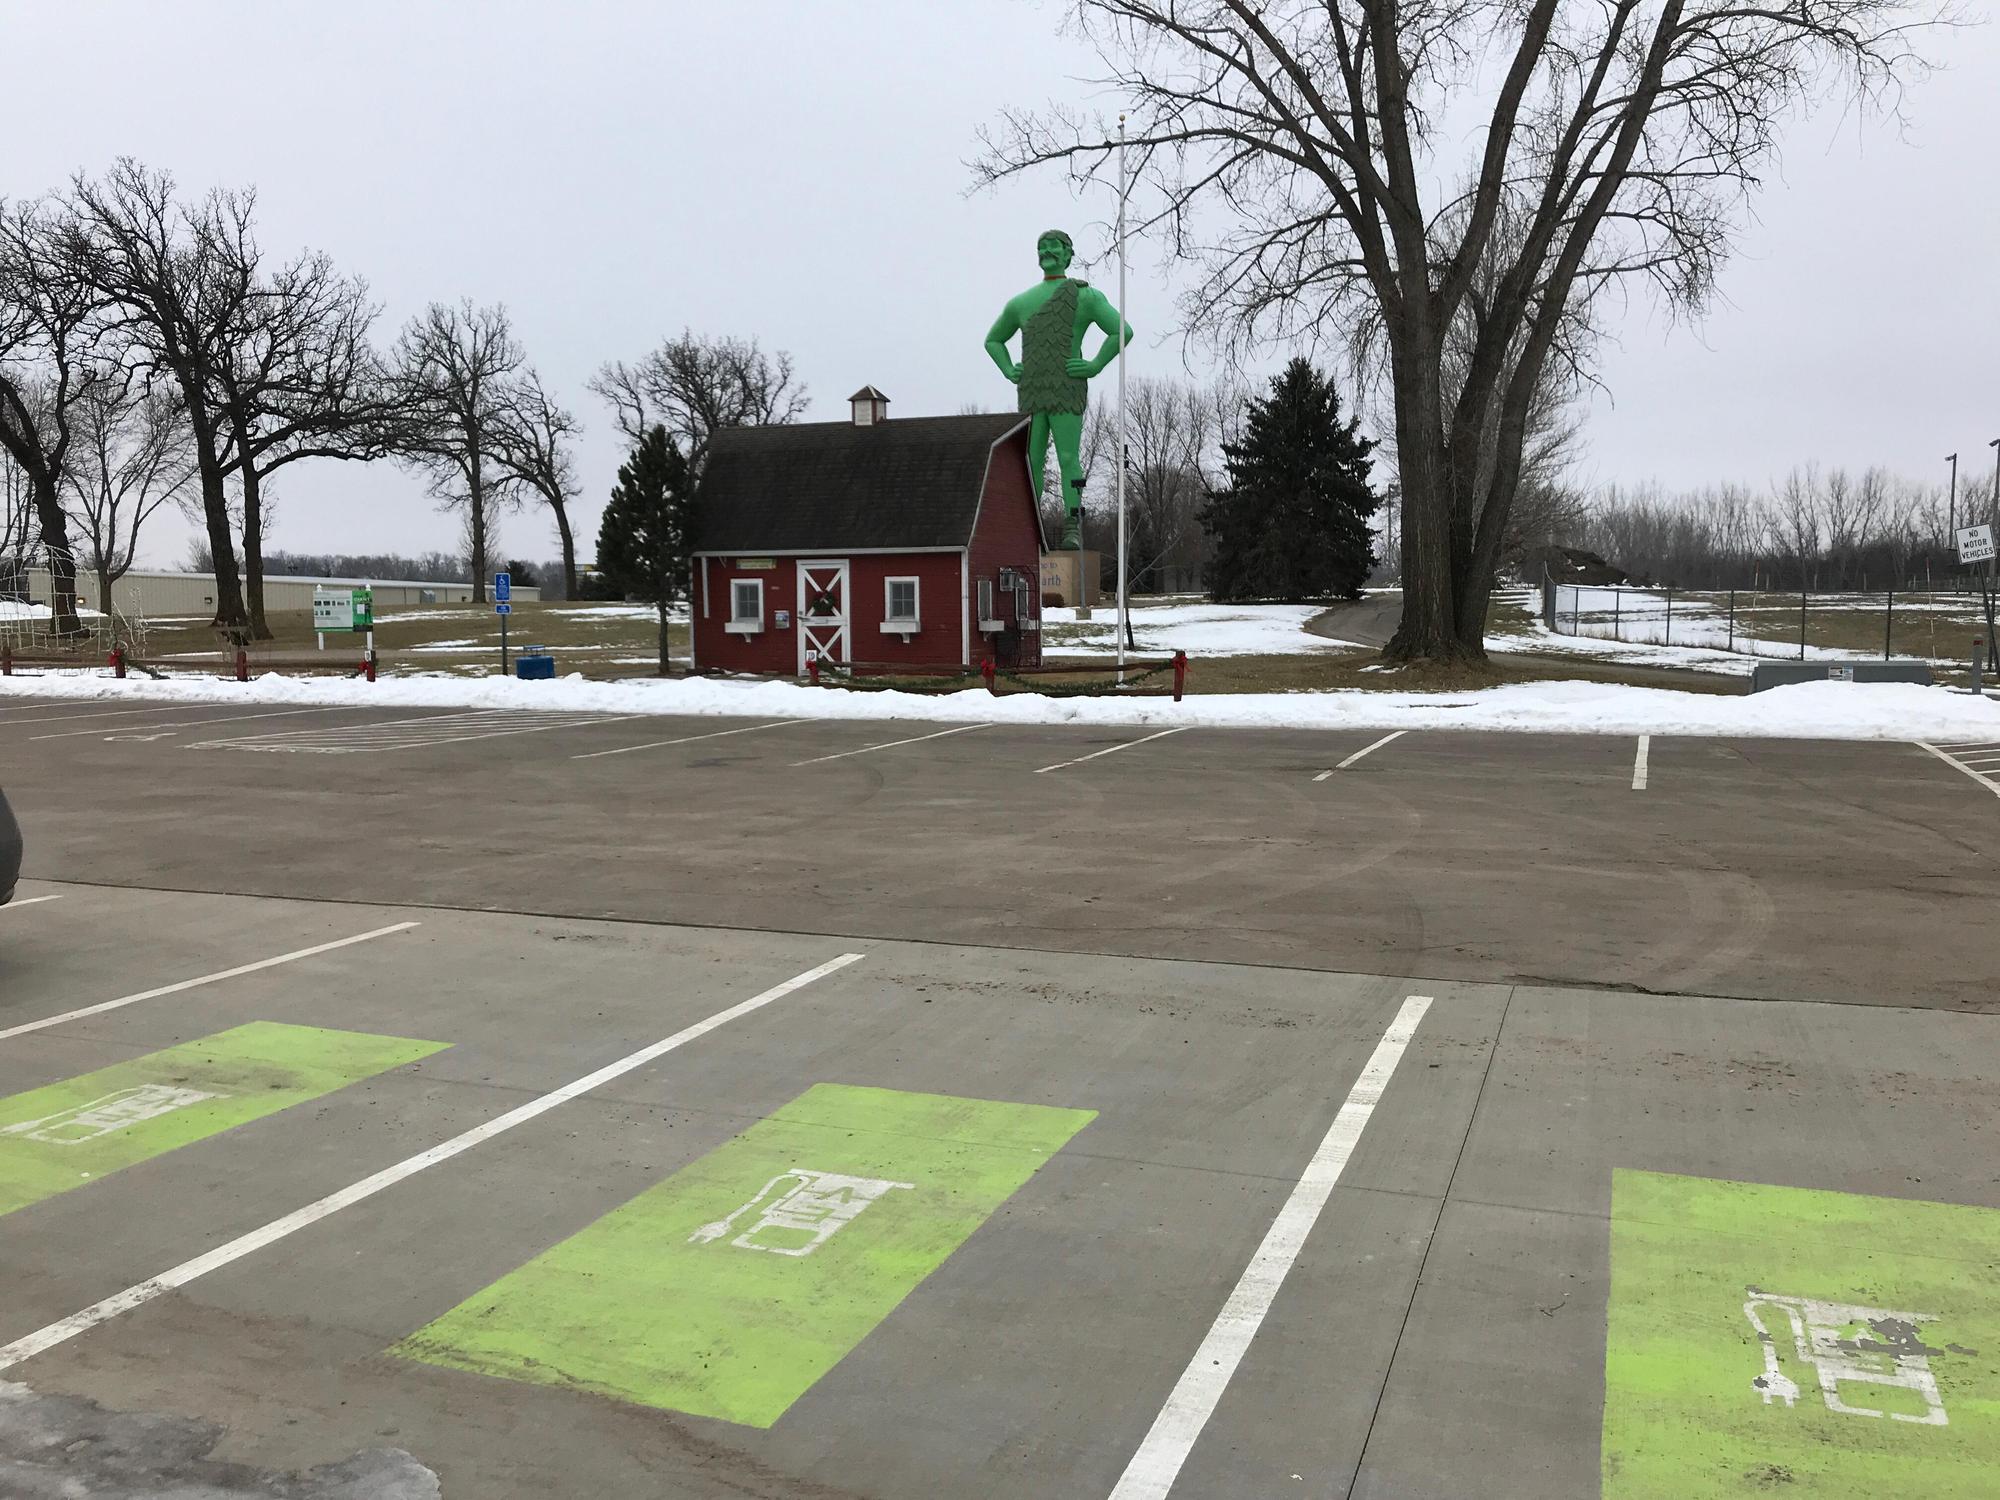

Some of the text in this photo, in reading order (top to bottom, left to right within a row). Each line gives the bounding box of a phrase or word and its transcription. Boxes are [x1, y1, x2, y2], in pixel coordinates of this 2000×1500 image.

[1968, 530, 1979, 539] NO
[1963, 538, 1988, 549] MOTOR
[1961, 546, 1994, 560] VEHICLES
